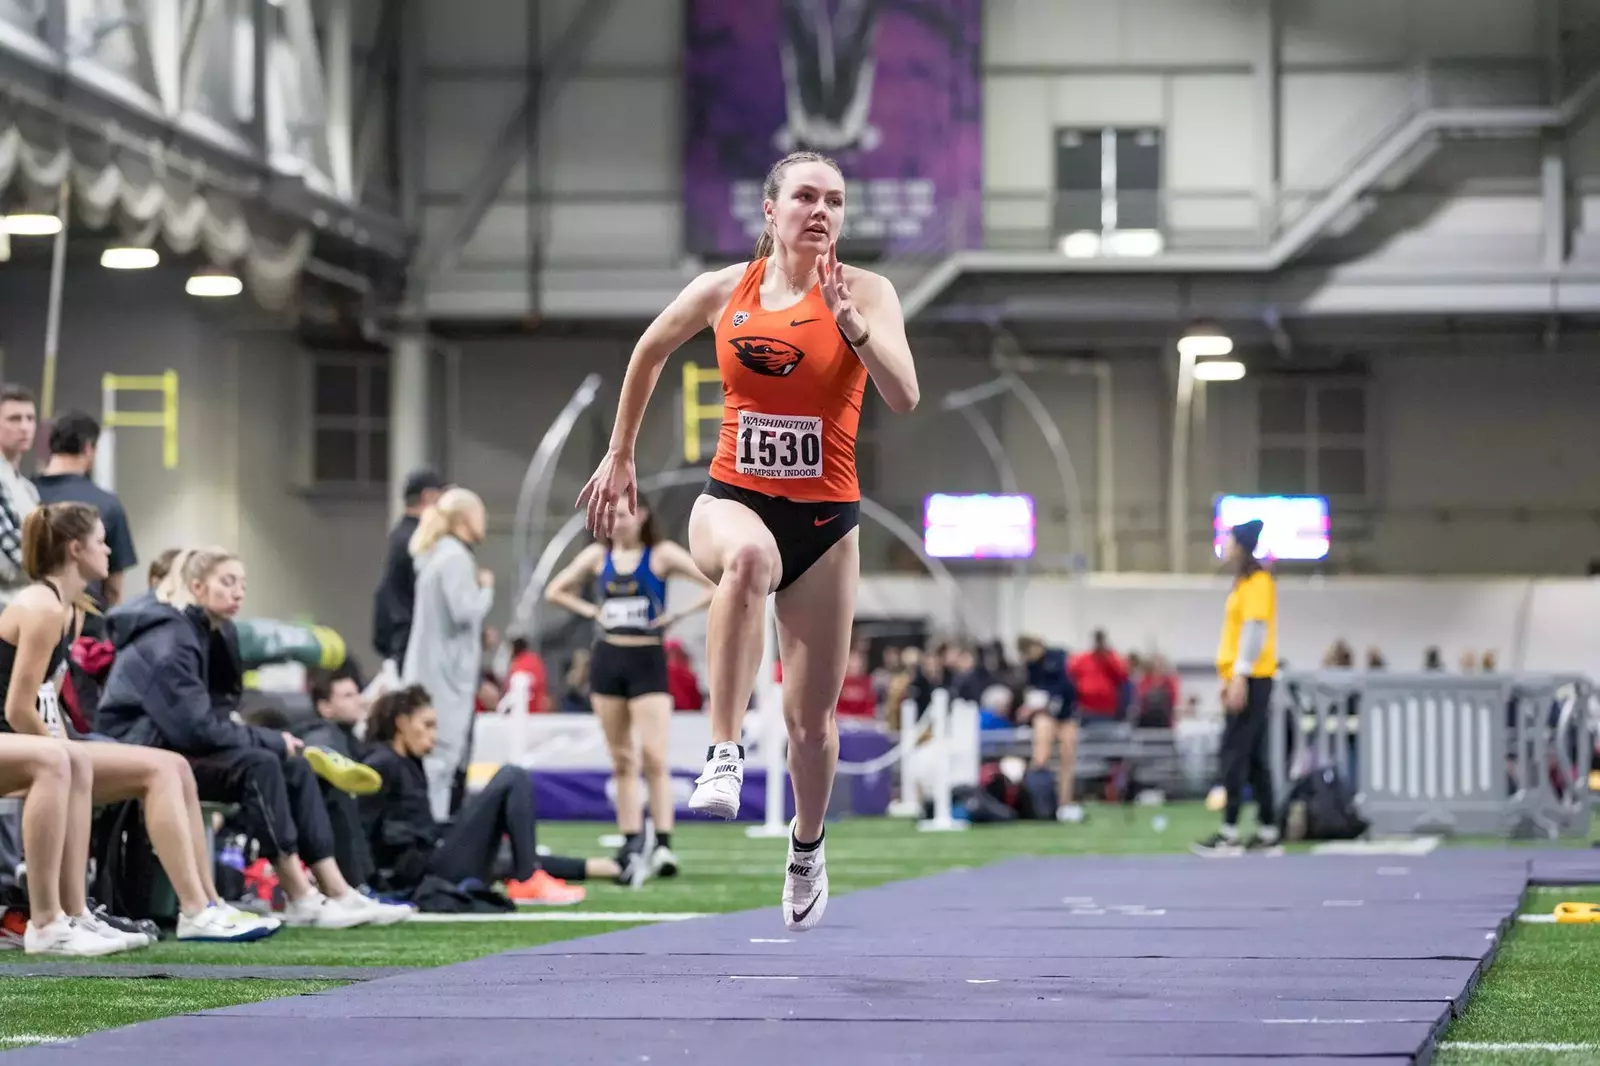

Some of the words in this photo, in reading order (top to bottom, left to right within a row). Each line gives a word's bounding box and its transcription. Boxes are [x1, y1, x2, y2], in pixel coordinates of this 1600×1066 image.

[742, 415, 817, 431] WASHINGTON
[740, 428, 820, 467] 1530
[743, 467, 782, 477] DEMPSEY
[784, 468, 817, 477] INDOOR
[714, 764, 738, 775] NIKE
[787, 862, 813, 877] NIKE
